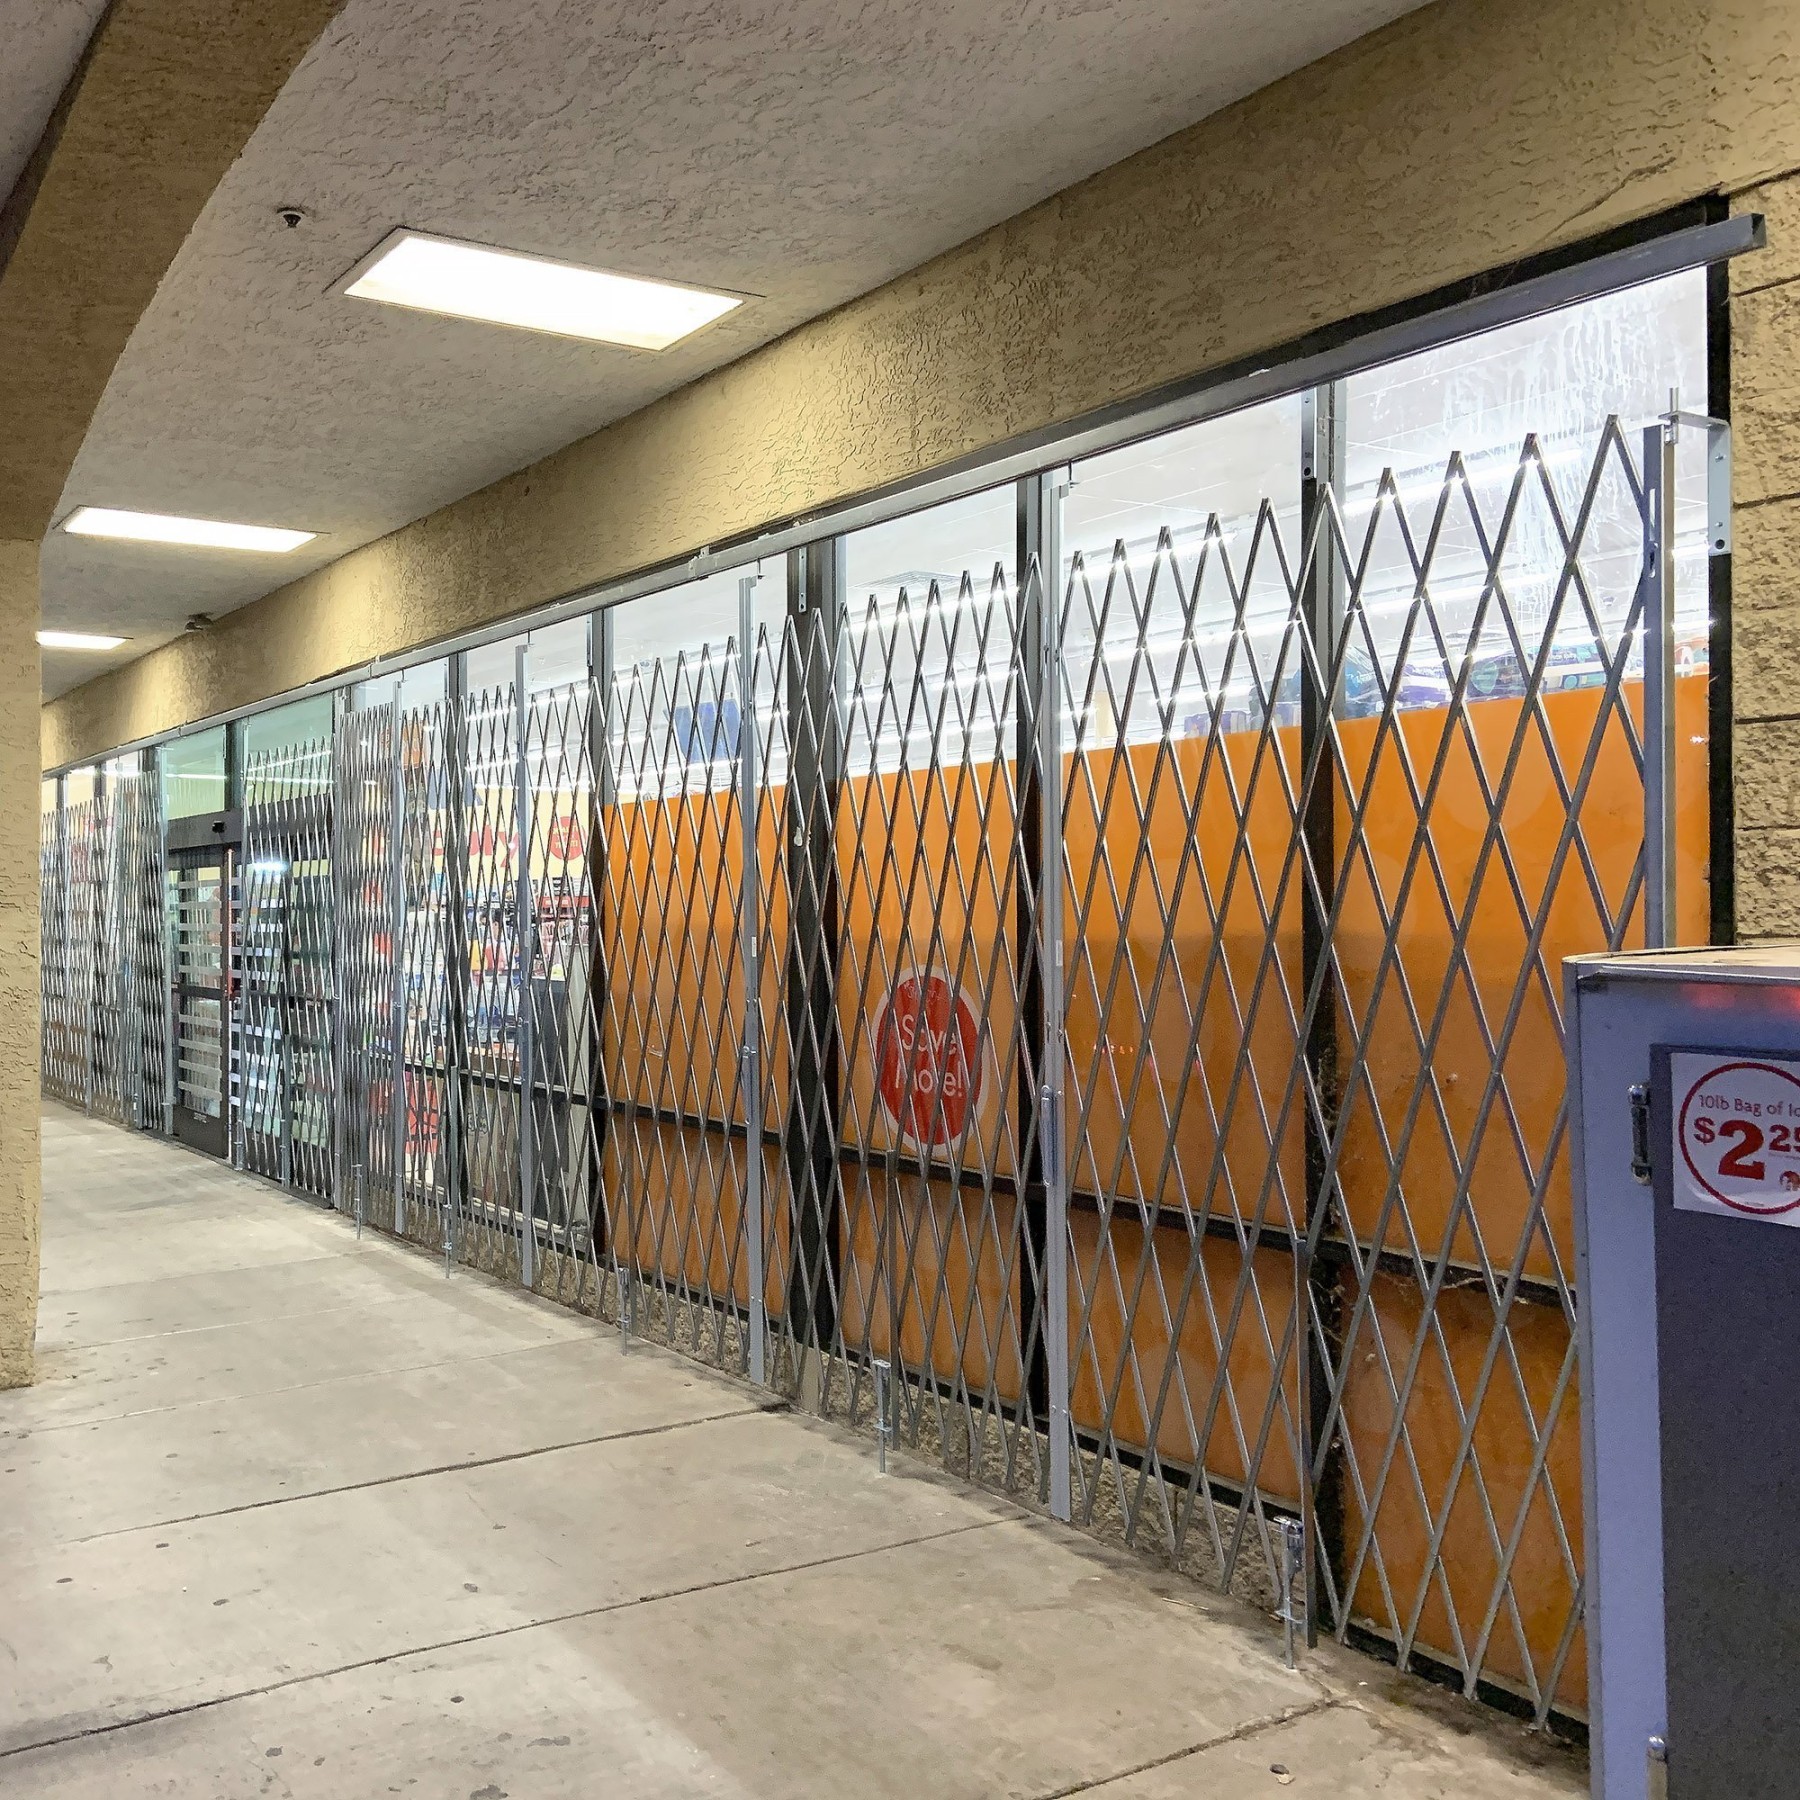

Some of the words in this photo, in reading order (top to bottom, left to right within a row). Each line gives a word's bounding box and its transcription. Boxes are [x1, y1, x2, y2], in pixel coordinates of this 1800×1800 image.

[1698, 1094, 1730, 1110] 10lb
[1734, 1097, 1762, 1117] Bag
[1766, 1100, 1784, 1115] of
